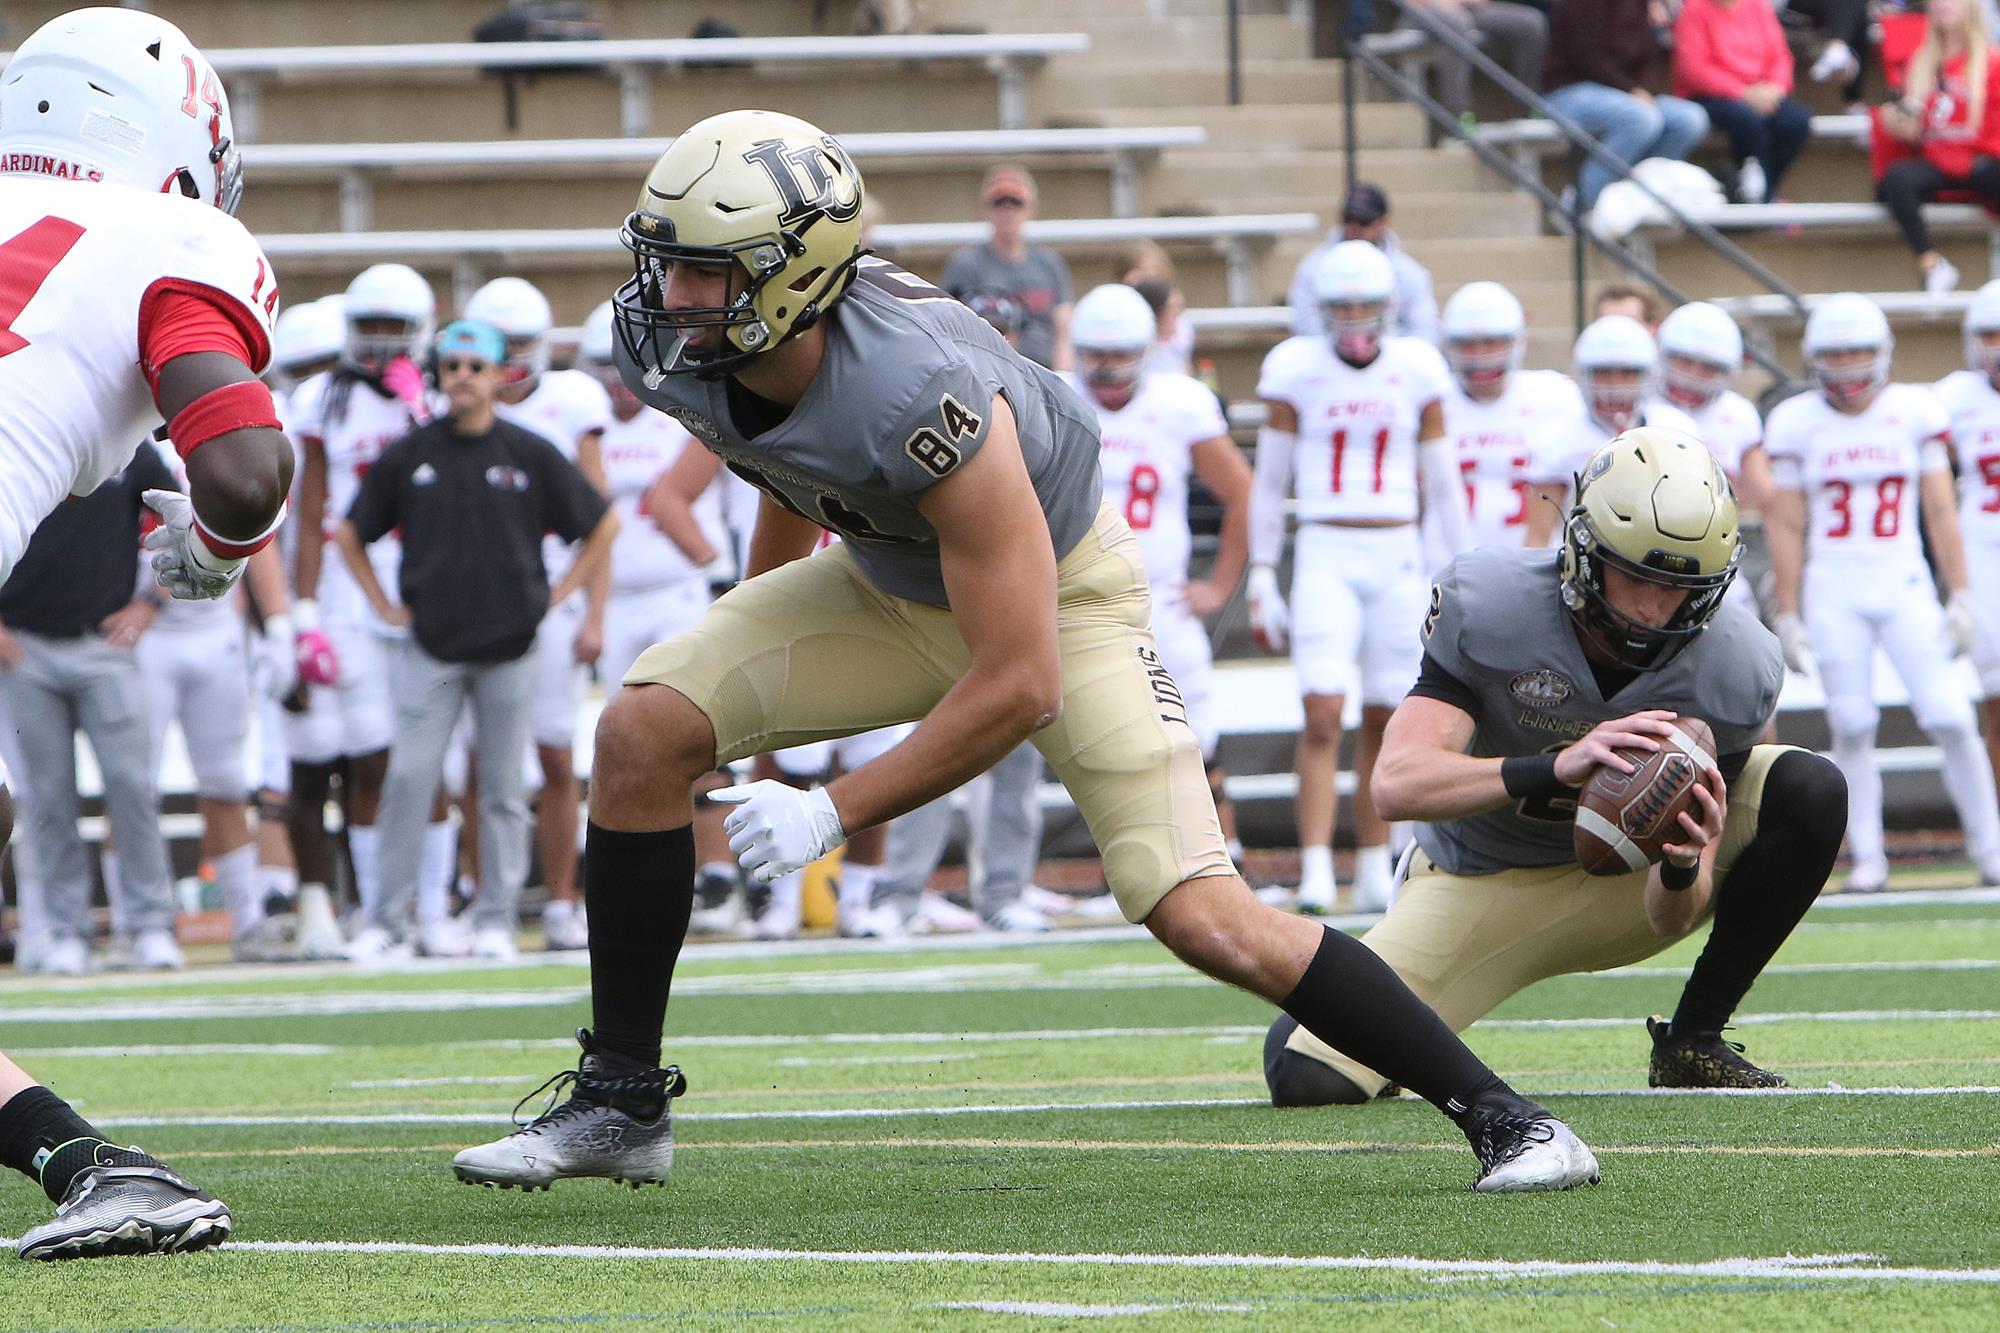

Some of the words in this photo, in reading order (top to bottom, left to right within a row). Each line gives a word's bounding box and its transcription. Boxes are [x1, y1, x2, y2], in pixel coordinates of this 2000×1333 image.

[181, 54, 224, 119] 14
[905, 392, 983, 478] 84
[1330, 429, 1389, 493] 11
[1126, 465, 1160, 529] 8
[1825, 477, 1905, 538] 38
[1137, 646, 1189, 727] LIONS
